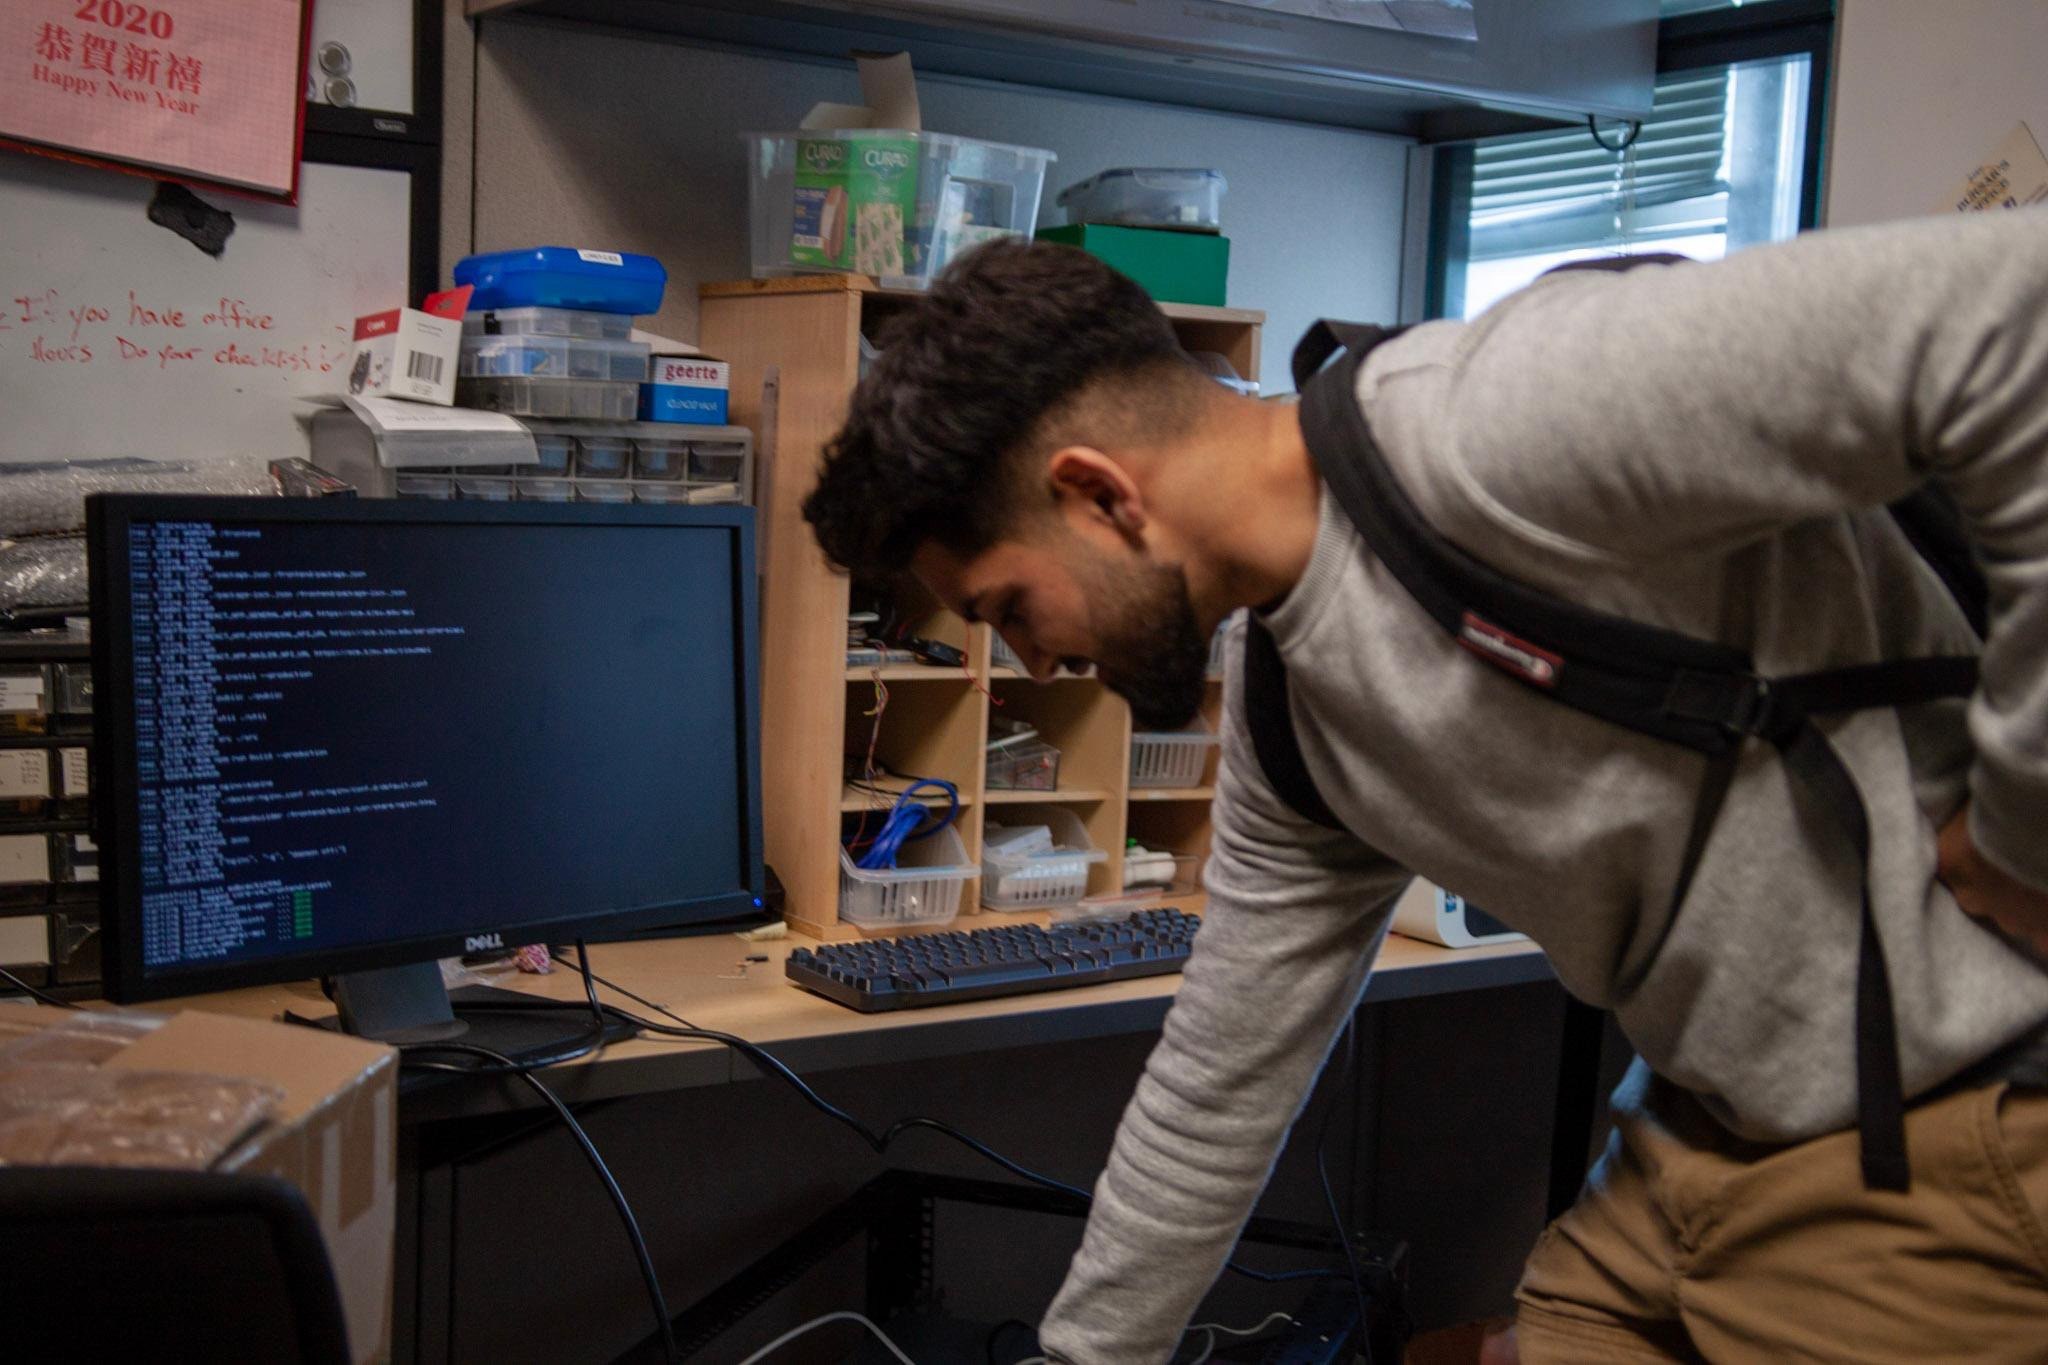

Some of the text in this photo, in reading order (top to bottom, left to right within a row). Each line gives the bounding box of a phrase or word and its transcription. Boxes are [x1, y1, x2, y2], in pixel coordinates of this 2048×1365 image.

[75, 0, 174, 40] 2020
[34, 22, 203, 95] 恭賀新禧
[32, 62, 200, 115] Happy New Year
[69, 304, 110, 342] you
[128, 289, 187, 327] have
[202, 297, 275, 330] office
[116, 335, 149, 360] Do
[158, 344, 202, 369] your
[465, 933, 504, 952] DELL
